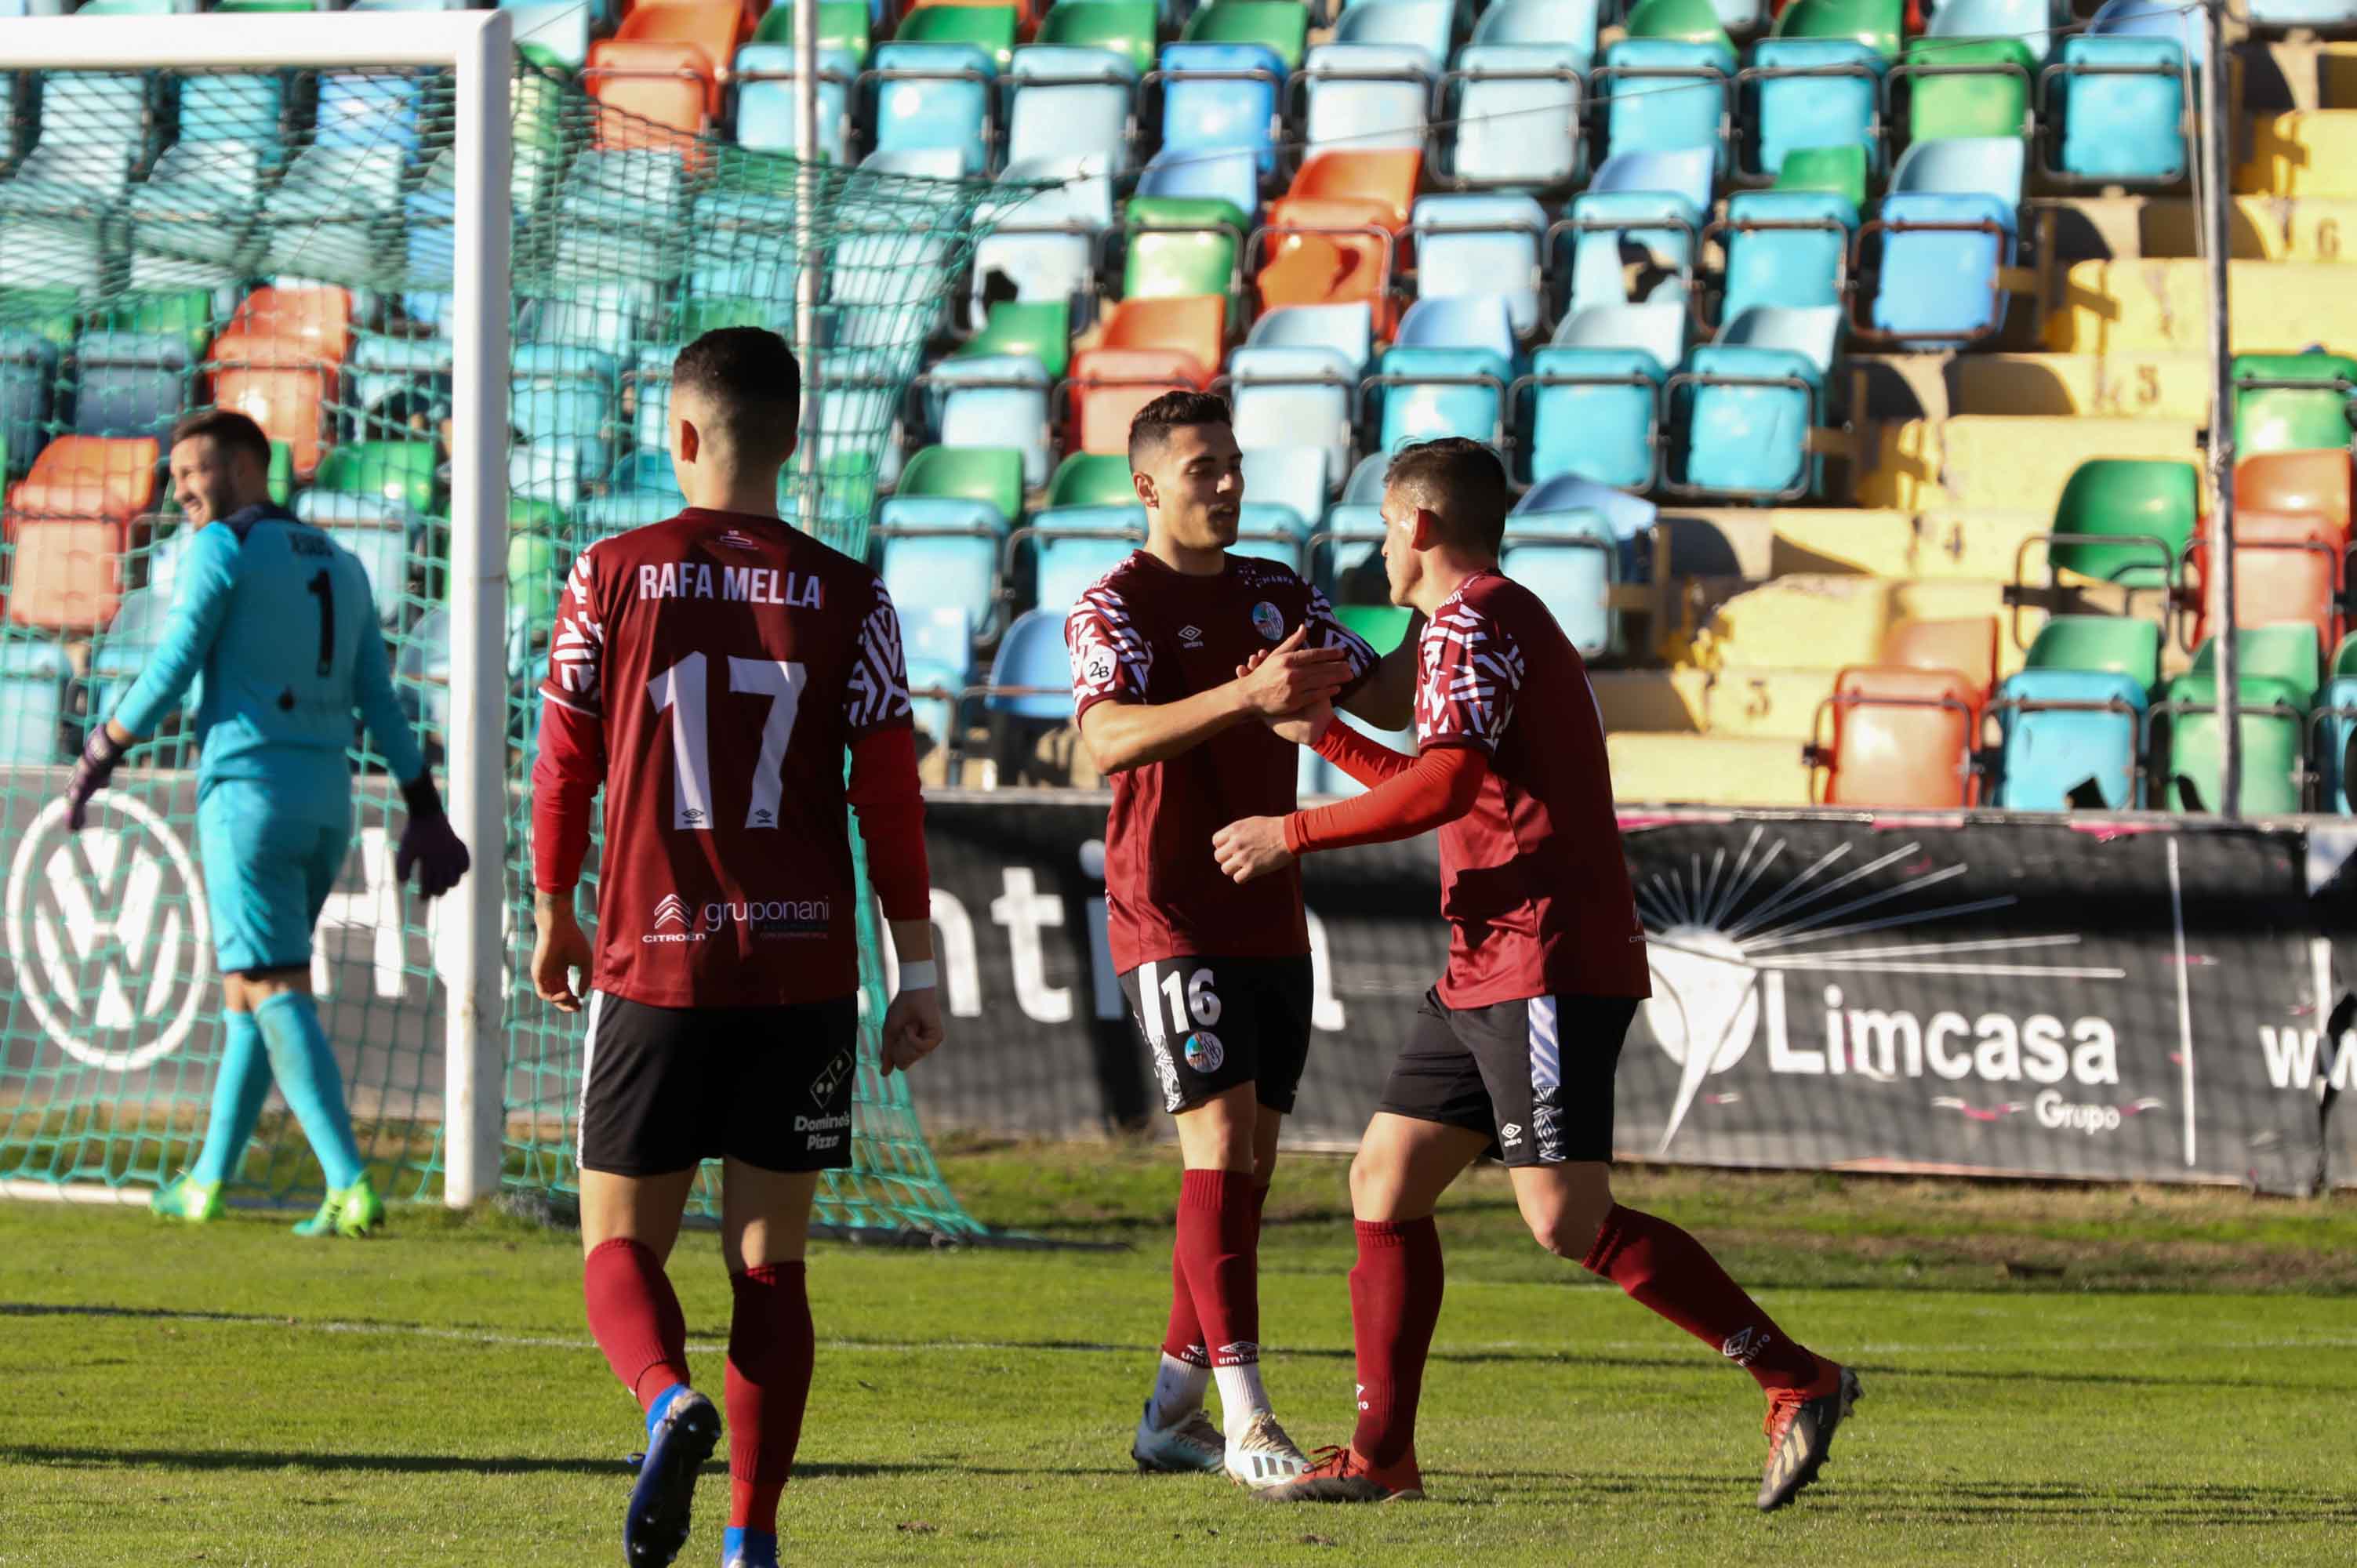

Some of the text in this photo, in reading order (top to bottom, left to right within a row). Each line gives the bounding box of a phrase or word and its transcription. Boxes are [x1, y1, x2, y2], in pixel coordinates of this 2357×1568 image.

[639, 561, 822, 610] RAFA MELLA
[307, 568, 336, 677] 1
[646, 650, 808, 829] 17
[704, 896, 829, 931] gruponani
[1160, 967, 1222, 1034] 16
[1763, 969, 2119, 1084] Limcasa
[2034, 1090, 2121, 1134] Grupo
